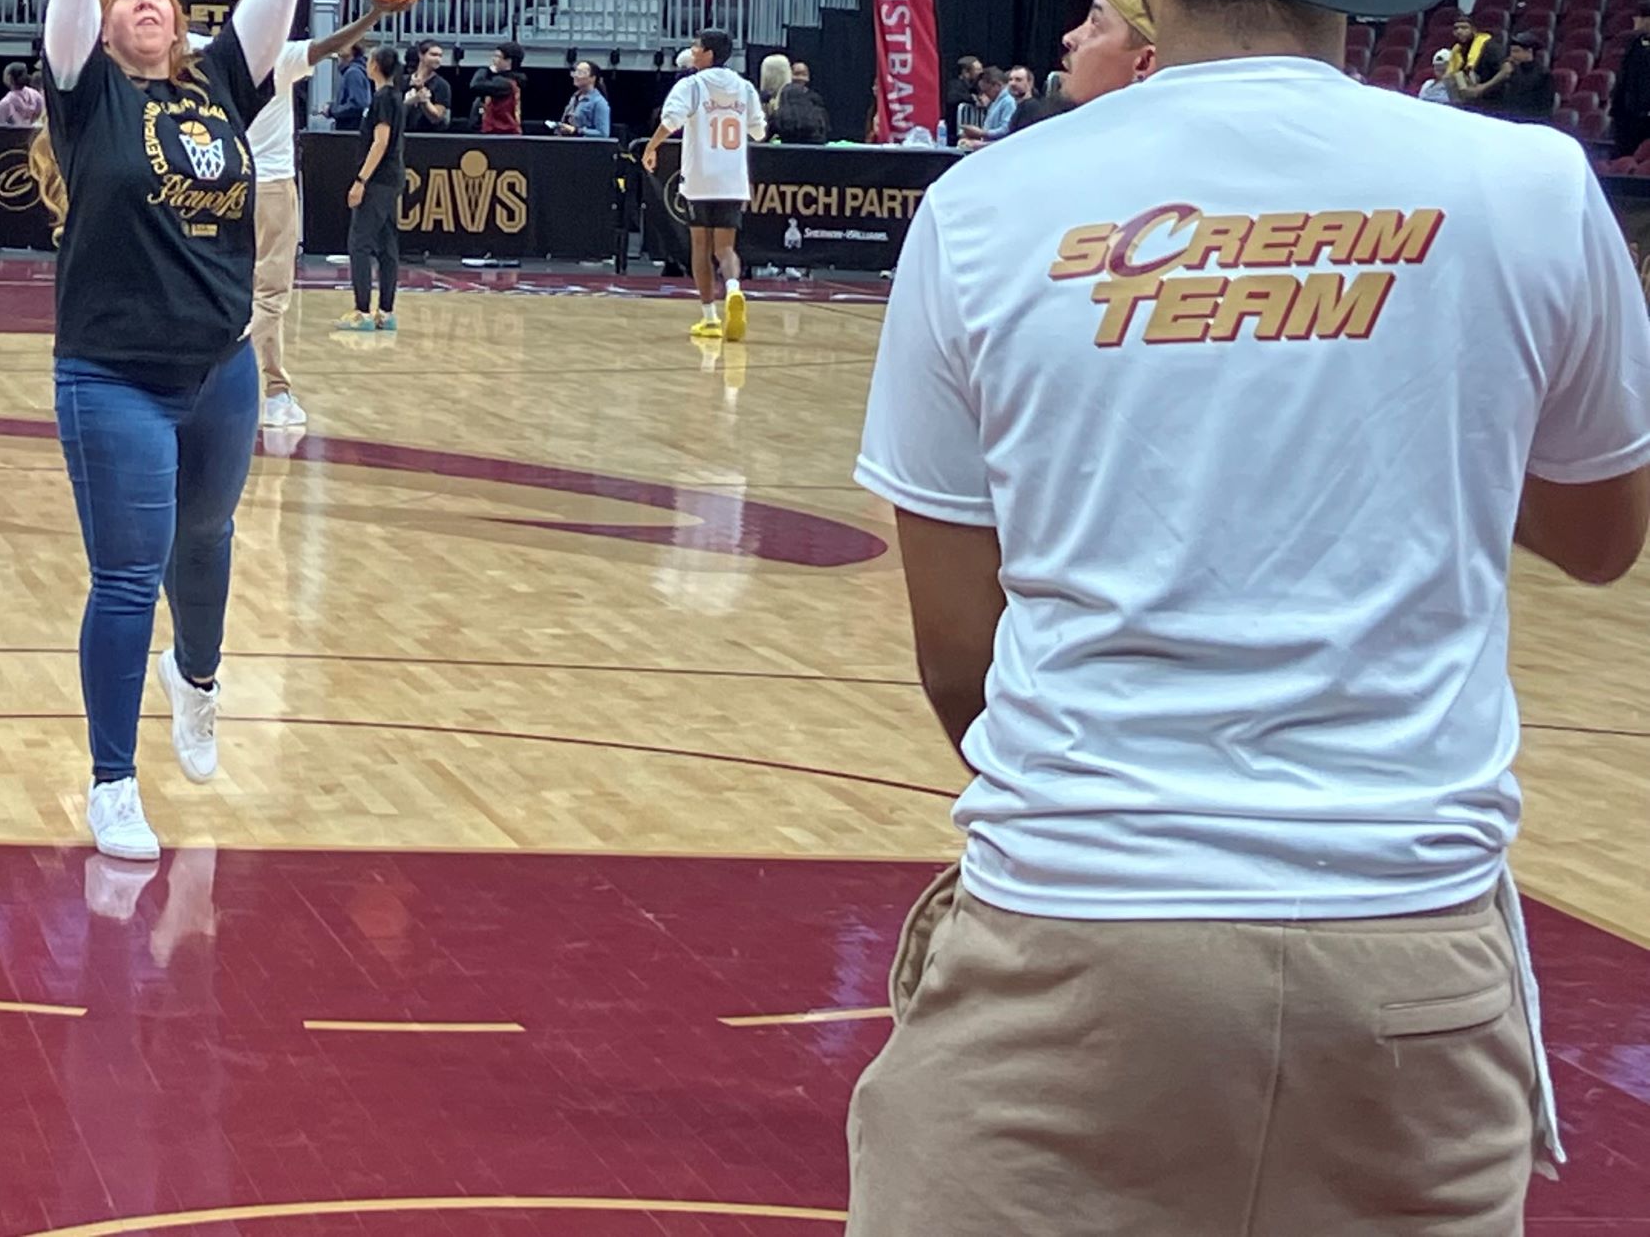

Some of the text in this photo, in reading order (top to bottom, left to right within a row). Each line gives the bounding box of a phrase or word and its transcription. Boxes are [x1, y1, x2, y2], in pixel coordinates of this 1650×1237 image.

[189, 3, 230, 23] ET
[710, 117, 741, 151] 10
[147, 174, 249, 218] Playoffs
[397, 167, 528, 234] CAVS
[844, 186, 924, 219] PART
[1048, 202, 1446, 281] SCREAM
[1091, 271, 1396, 349] TEAM
